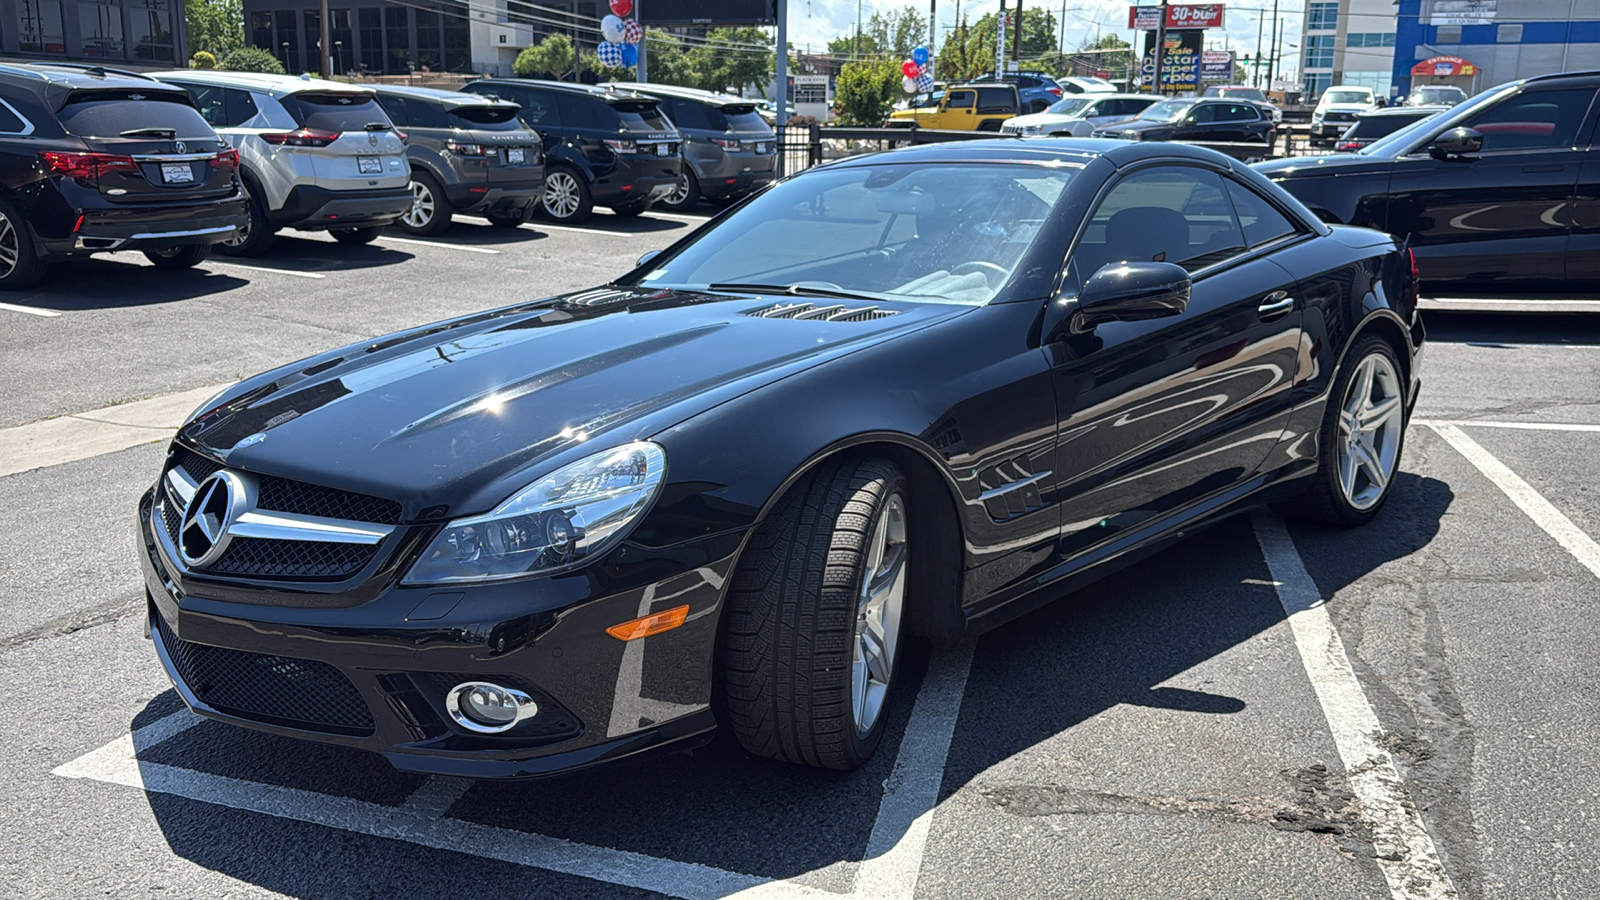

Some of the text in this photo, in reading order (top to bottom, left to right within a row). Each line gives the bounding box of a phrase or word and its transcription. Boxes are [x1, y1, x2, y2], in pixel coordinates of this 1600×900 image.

[1167, 47, 1193, 55] Sale
[1144, 55, 1199, 65] nctar
[1141, 73, 1196, 84] prple
